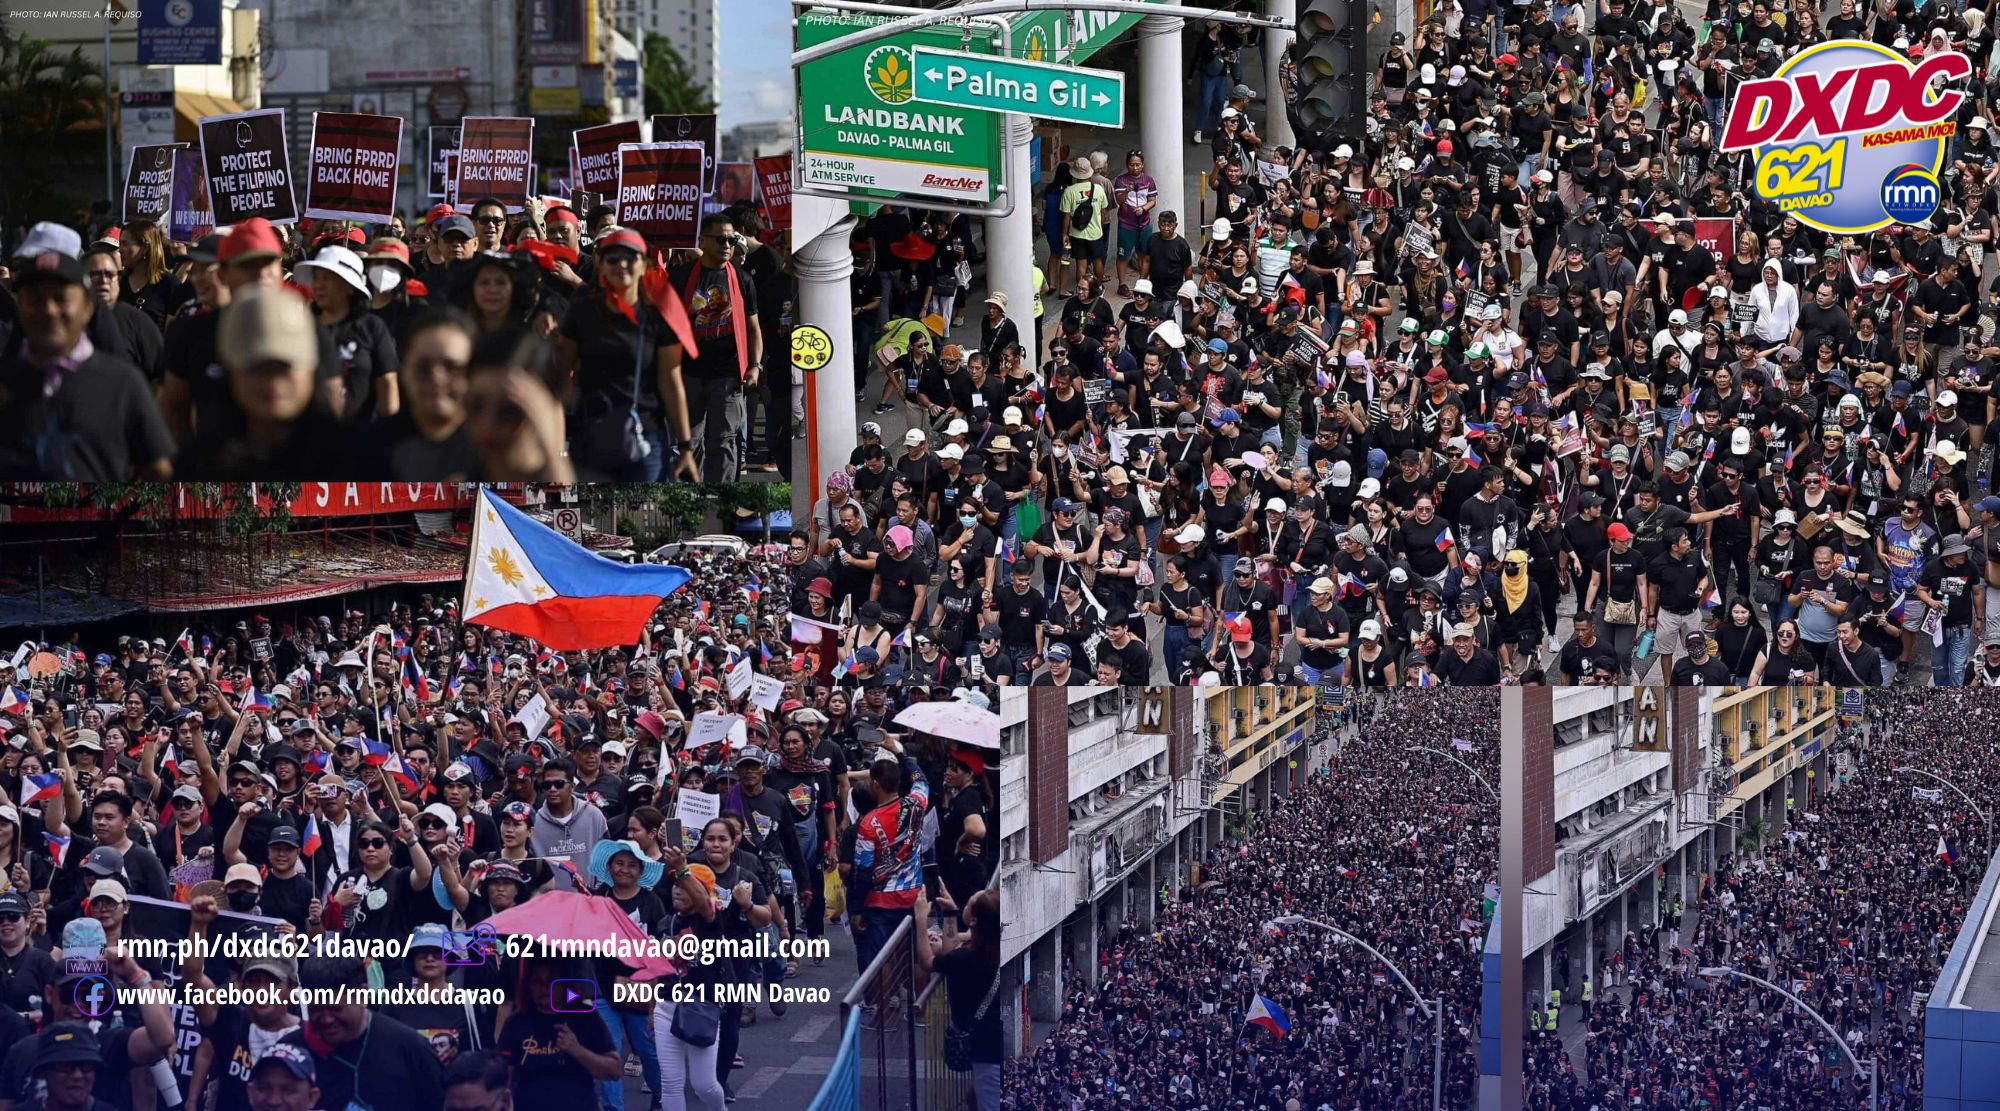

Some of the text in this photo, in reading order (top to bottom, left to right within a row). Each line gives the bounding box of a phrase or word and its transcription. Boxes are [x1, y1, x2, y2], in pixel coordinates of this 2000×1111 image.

[947, 65, 1087, 110] Palma Gil
[824, 104, 965, 136] LANDBANK
[838, 130, 879, 146] DAVAO
[888, 137, 932, 152] PALMA
[934, 140, 954, 153] GIL
[220, 150, 272, 172] PROTECT
[315, 147, 395, 170] BRING FPRRD
[462, 149, 494, 163] BRING
[495, 149, 529, 164] FPRRD
[581, 153, 611, 170] BRING
[810, 158, 855, 172] 24-HOUR
[139, 169, 173, 184] PROTECT
[212, 169, 285, 194] THE FILIPINO
[317, 166, 389, 188] BACK HOME
[464, 166, 524, 182] BACK HOME
[587, 168, 613, 184] BACK
[767, 173, 782, 184] WE
[811, 170, 875, 185] ATM SERVICE
[921, 173, 984, 191] BancNet
[129, 185, 146, 198] THE
[622, 184, 699, 203] BRING FPRRD
[766, 182, 792, 195] FILIPI
[137, 199, 164, 214] PEOPLE
[230, 190, 275, 212] PEOPLE
[175, 210, 188, 225] WE
[623, 204, 655, 222] BACK
[656, 203, 693, 221] HOME
[1302, 341, 1318, 355] STAND
